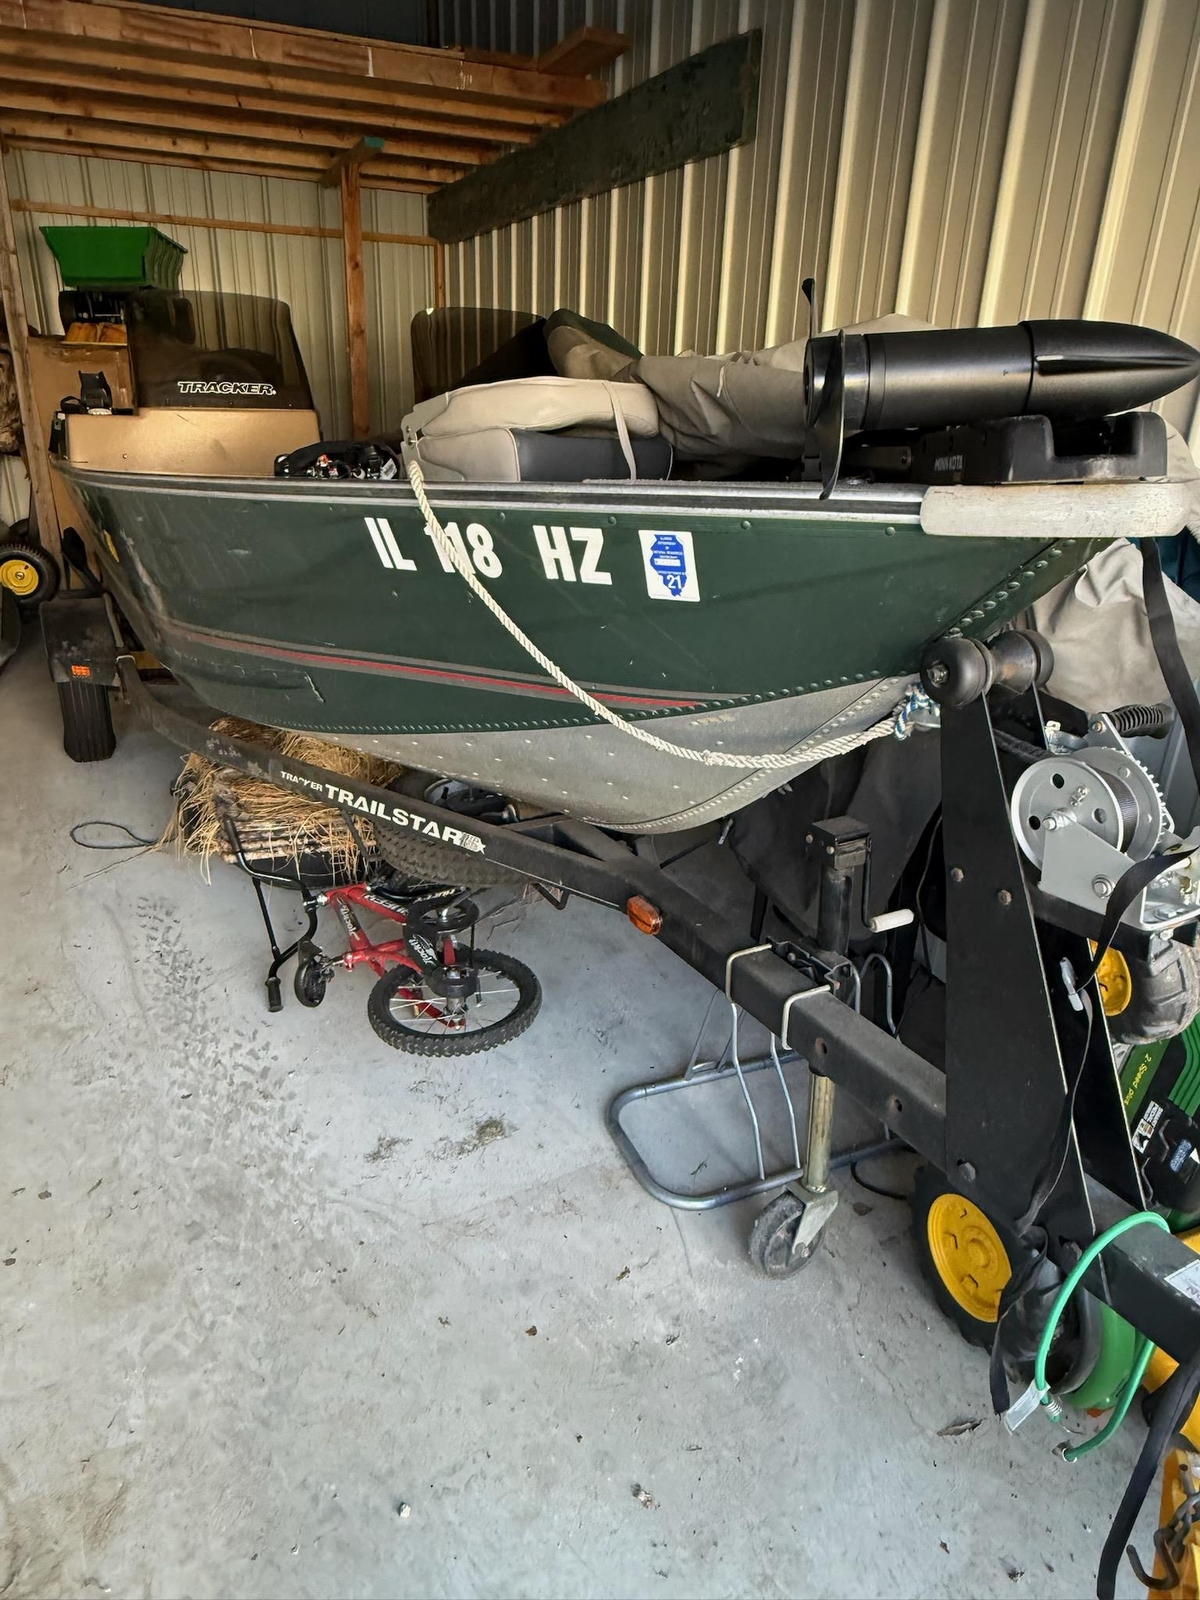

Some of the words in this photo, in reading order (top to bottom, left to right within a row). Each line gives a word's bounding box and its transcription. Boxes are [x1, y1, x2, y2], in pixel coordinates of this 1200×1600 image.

[364, 517, 418, 571] IL
[423, 521, 503, 579] 118
[533, 525, 613, 585] HZ
[666, 574, 682, 589] 21
[324, 783, 464, 847] TRAILSTAR
